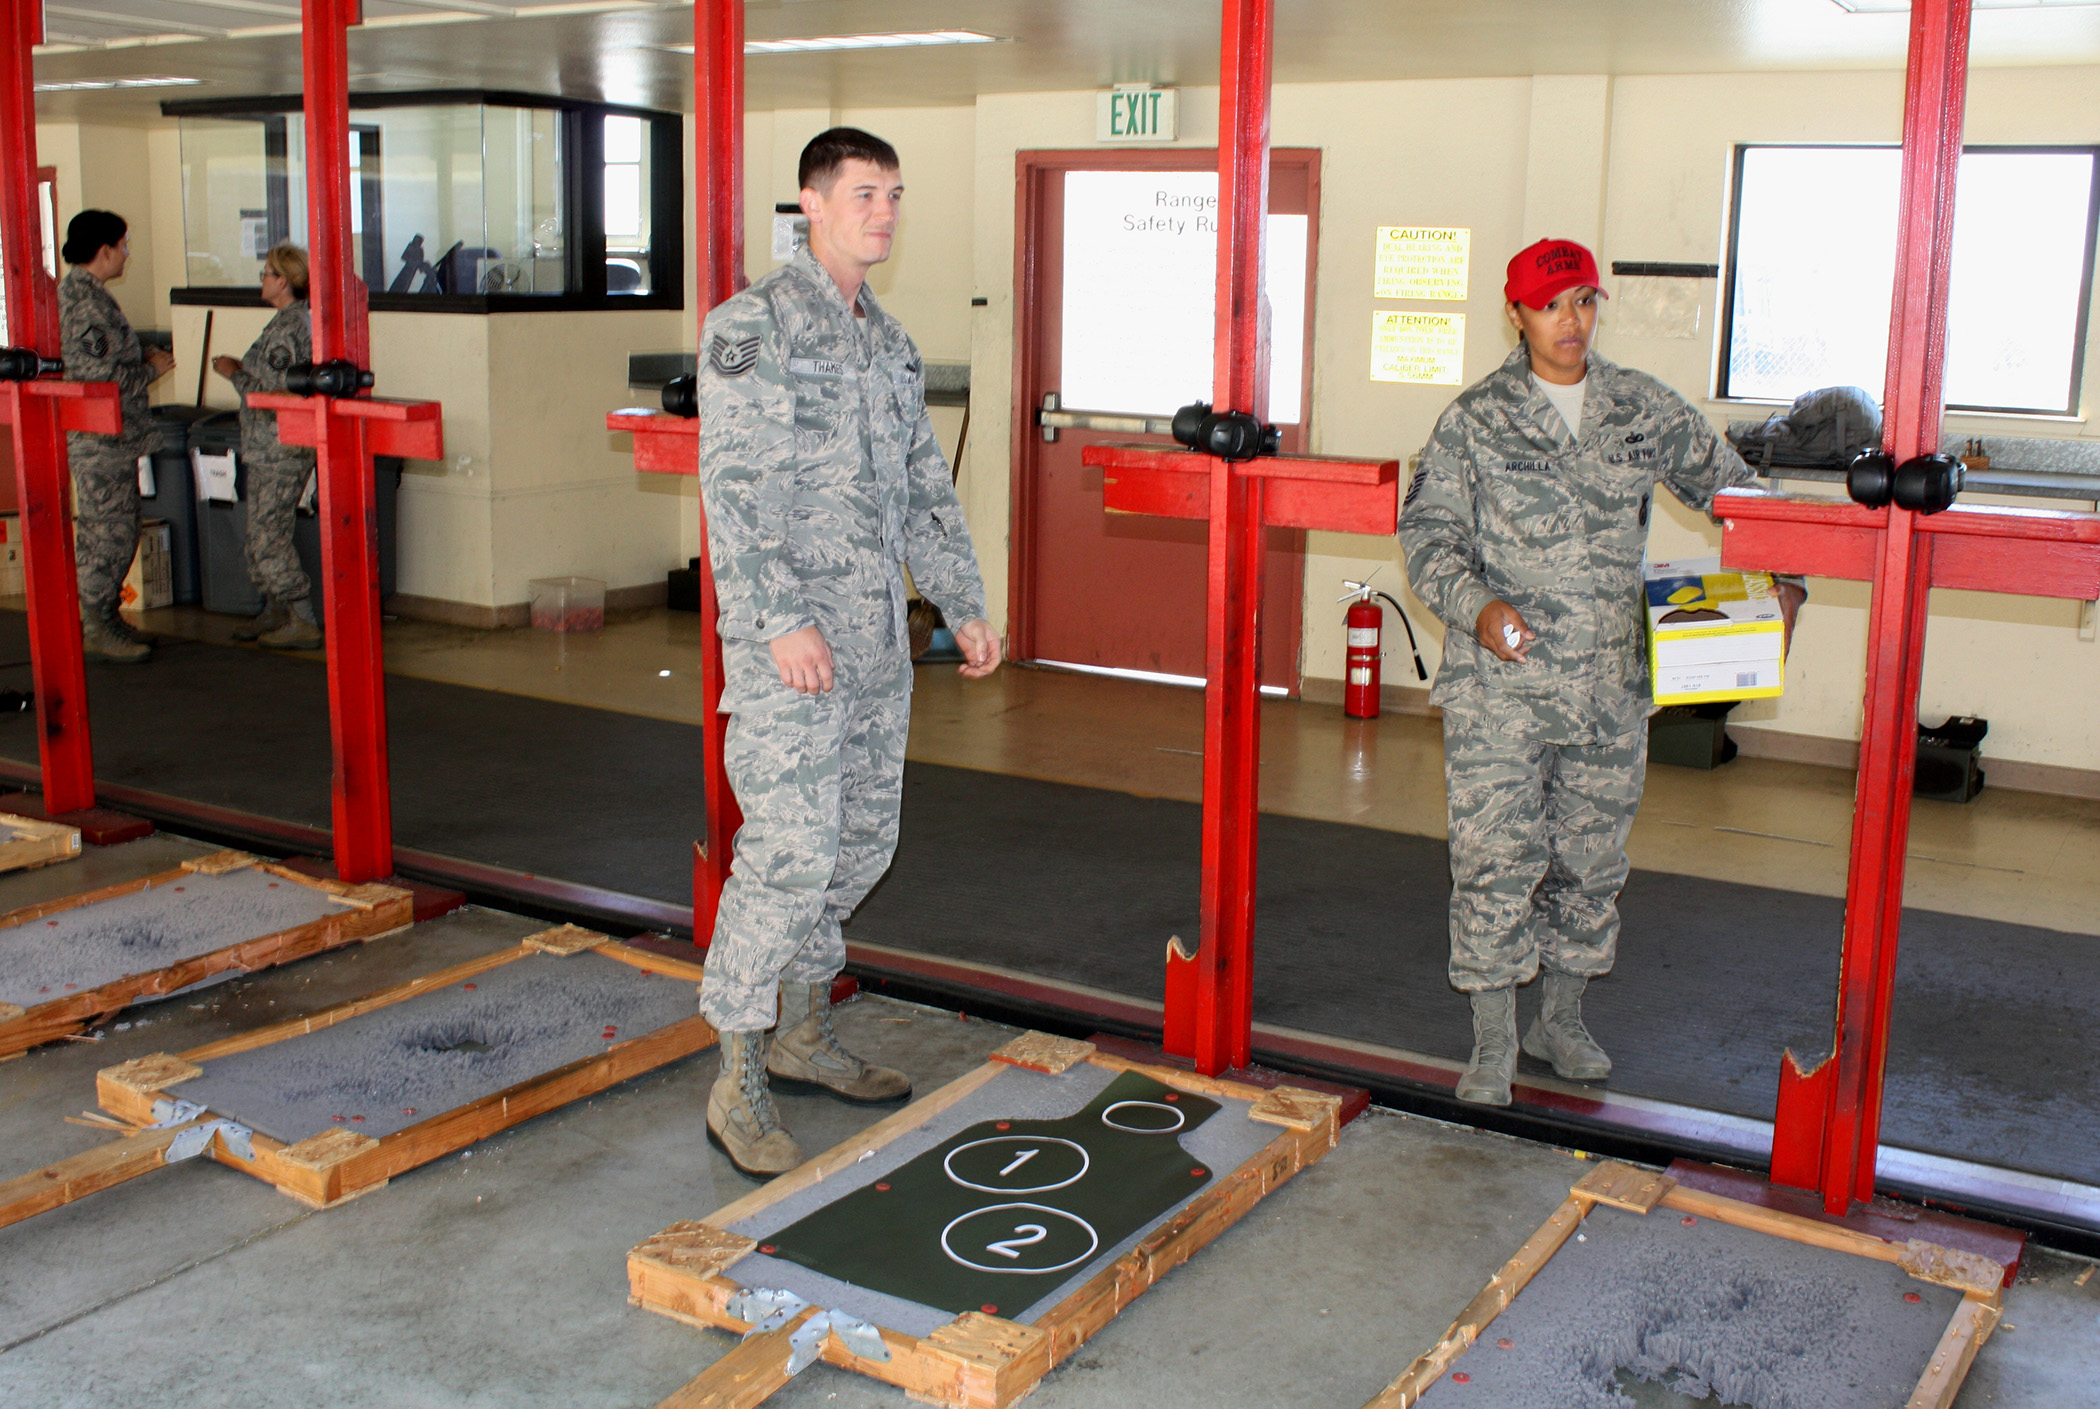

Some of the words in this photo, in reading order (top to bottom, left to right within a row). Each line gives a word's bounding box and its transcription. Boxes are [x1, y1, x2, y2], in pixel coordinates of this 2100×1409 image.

[1111, 92, 1162, 136] EXIT
[1156, 190, 1217, 211] Range
[1123, 213, 1186, 235] Safety
[1390, 229, 1457, 241] CAUTION!
[1536, 246, 1582, 267] COMBAT
[1547, 260, 1581, 275] ARMS
[1504, 461, 1551, 472] ARCHILLA
[1608, 452, 1626, 463] U.S.
[1628, 449, 1640, 461] AIR
[1742, 572, 1770, 600] LASSIC
[999, 1148, 1040, 1177] 1
[986, 1223, 1048, 1259] 2
